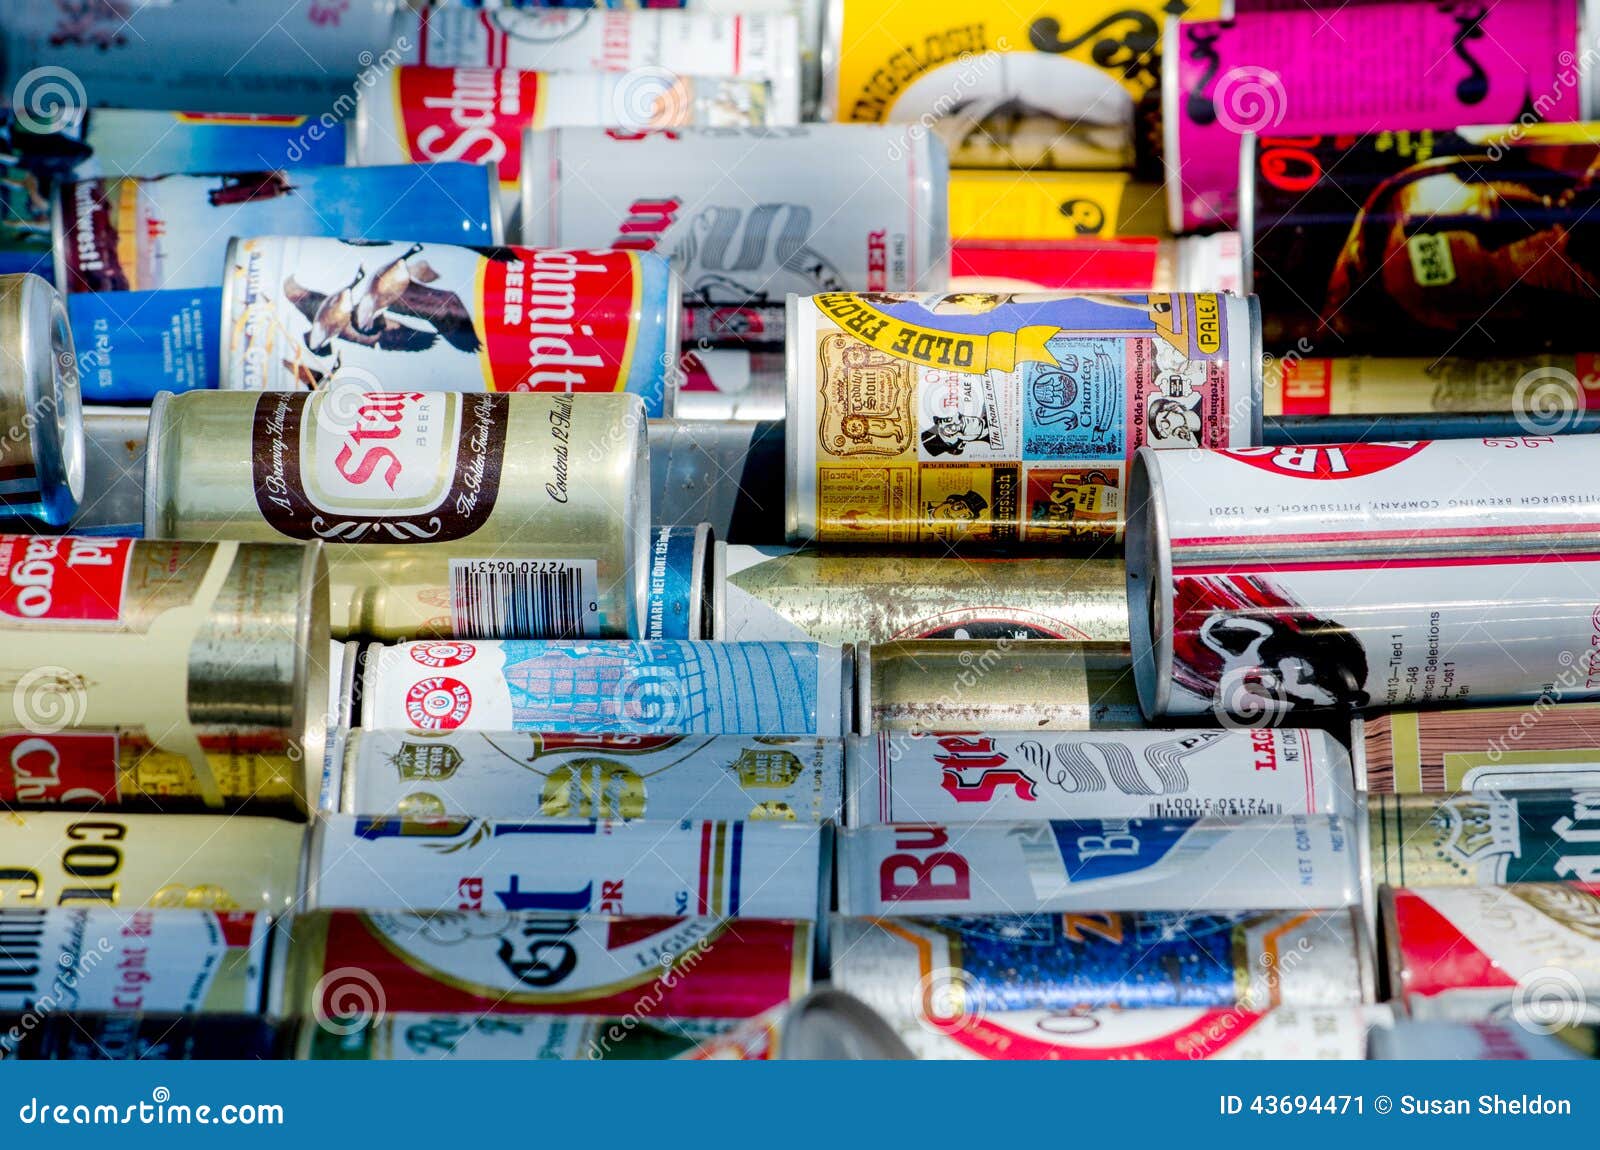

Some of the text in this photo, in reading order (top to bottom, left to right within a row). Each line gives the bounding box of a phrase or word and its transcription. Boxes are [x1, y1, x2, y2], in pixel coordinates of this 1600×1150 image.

[892, 327, 974, 367] OLDE
[864, 371, 877, 412] Stout
[416, 404, 430, 447] BEER
[1134, 403, 1143, 425] Olde
[550, 429, 570, 445] 12
[265, 437, 290, 495] Brewing
[545, 445, 570, 504] Contents
[1209, 507, 1245, 516] 15201
[1448, 497, 1512, 508] BREWING
[470, 561, 565, 574] 72720 06431
[653, 578, 664, 594] NET
[1425, 611, 1440, 672] Selections
[408, 678, 446, 730] IRON CITY
[451, 685, 469, 722] BEER
[930, 728, 1037, 803] Ste
